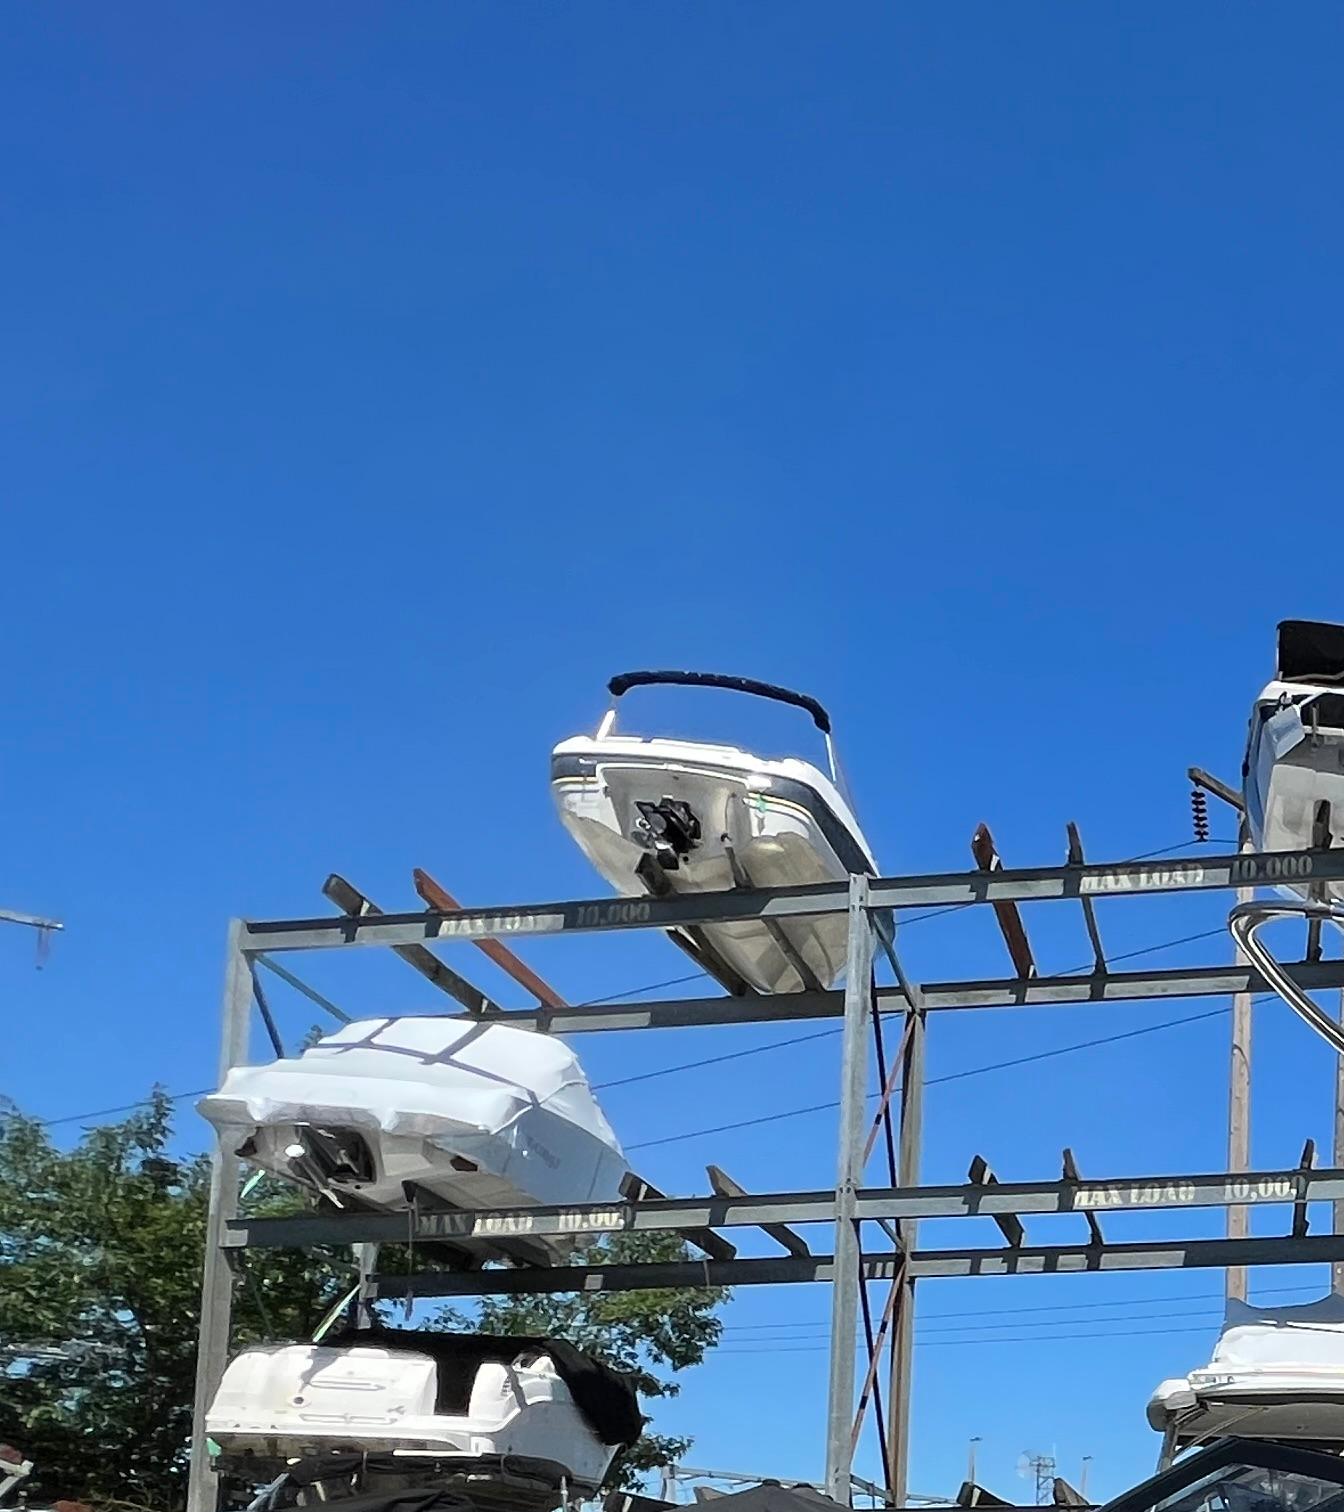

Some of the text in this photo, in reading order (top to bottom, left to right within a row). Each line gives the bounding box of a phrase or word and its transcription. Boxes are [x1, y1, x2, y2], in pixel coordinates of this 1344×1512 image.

[1080, 868, 1132, 891] MAX
[1139, 863, 1204, 887] LOAD
[1072, 1184, 1124, 1208] MAX
[1130, 1180, 1196, 1204] LOAD
[418, 1213, 467, 1236] MAX
